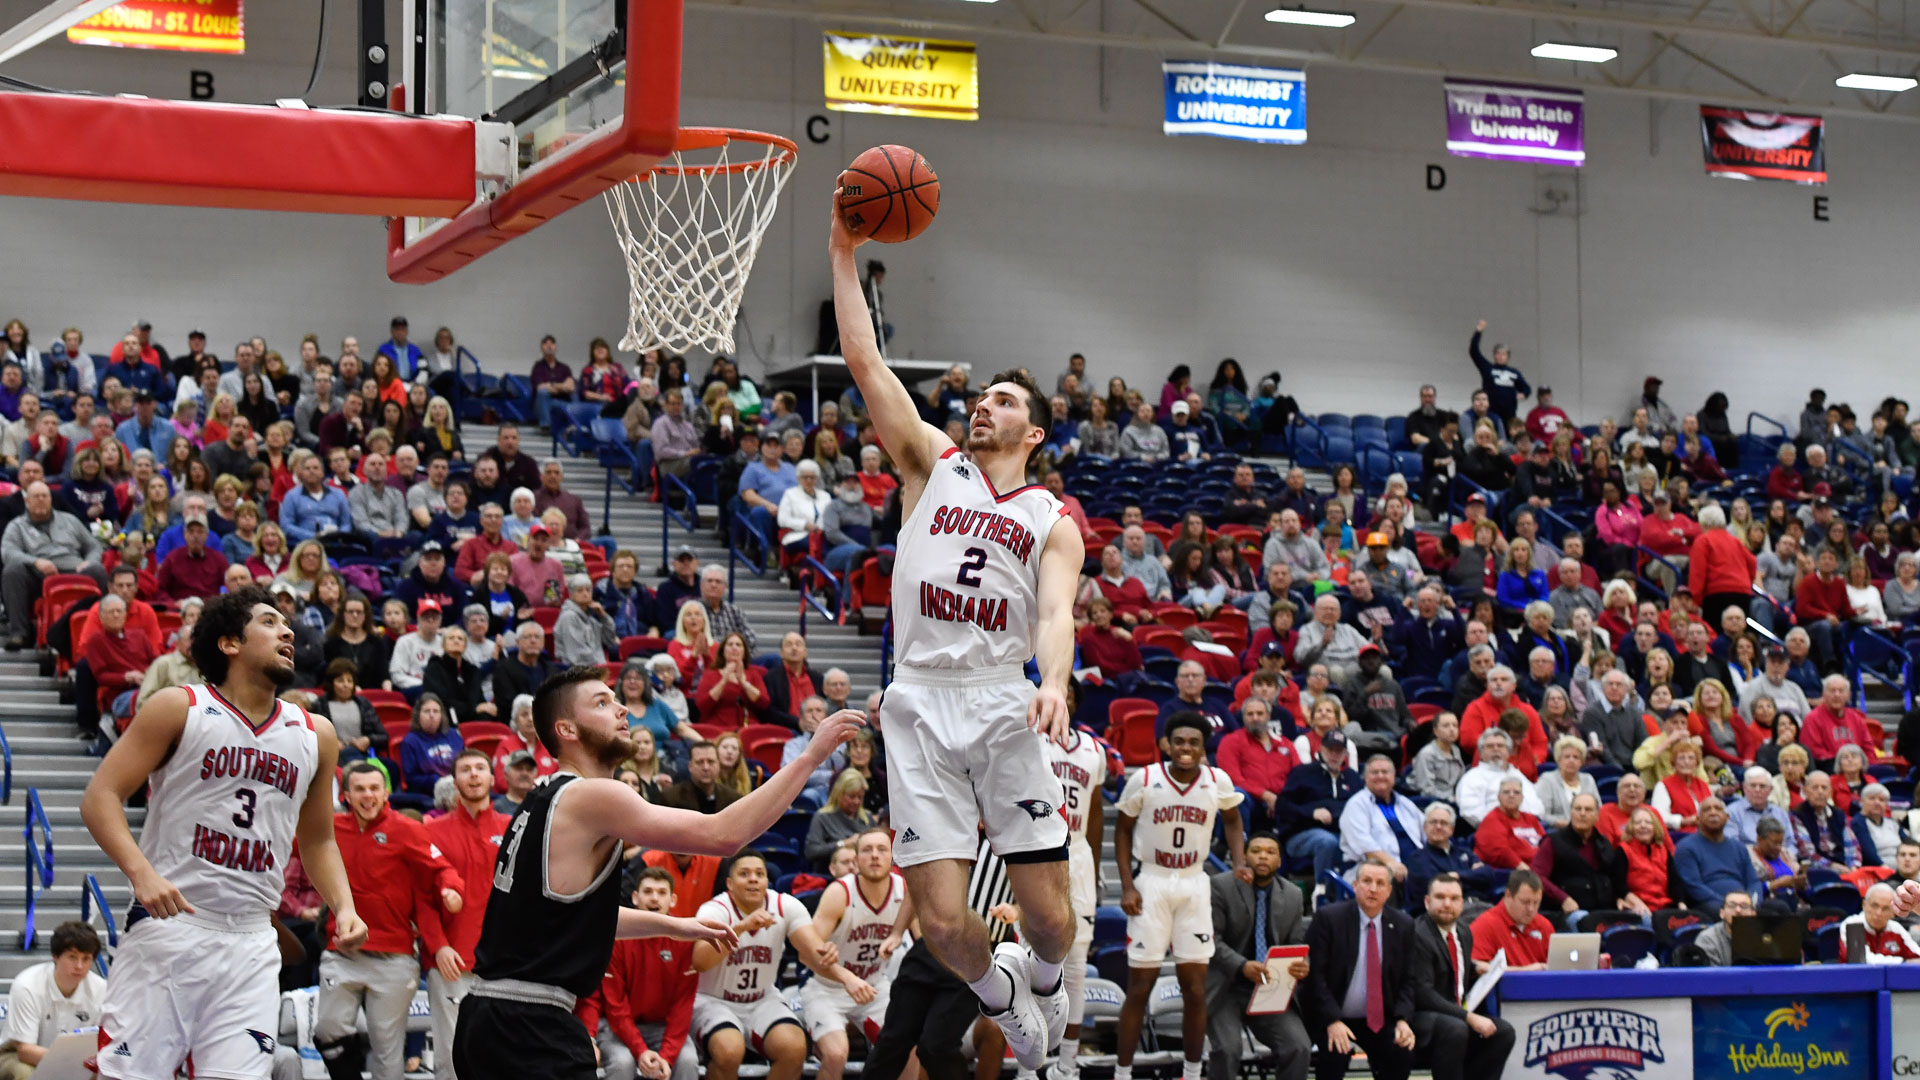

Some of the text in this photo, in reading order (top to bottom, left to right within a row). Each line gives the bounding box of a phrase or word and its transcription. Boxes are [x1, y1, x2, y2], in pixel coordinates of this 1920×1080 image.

[83, 7, 240, 35] SSOURI ST. LOUIS
[862, 51, 939, 70] QUINCY
[190, 70, 215, 99] B
[840, 76, 961, 99] UNIVERSITY
[1175, 75, 1294, 101] ROCKHURST
[1177, 101, 1292, 127] UNIVERSITY
[1454, 98, 1574, 124] Truman State
[806, 115, 830, 143] C
[1470, 119, 1559, 147] University
[1713, 142, 1813, 168] UNIVERSITY
[1426, 164, 1446, 191] D
[1814, 195, 1830, 221] E
[930, 505, 1036, 566] SOUTHERN
[956, 546, 988, 588] 2
[920, 581, 1008, 632] INDIANA
[201, 746, 299, 799] SOUTHERN
[1051, 761, 1090, 789] OUTHERN
[232, 788, 257, 829] 3
[1153, 804, 1208, 826] SOUTHERN
[192, 822, 274, 872] INDIANA
[1172, 826, 1185, 849] 0
[1155, 848, 1198, 869] INDIANA
[848, 922, 894, 942] SOUTHE
[726, 945, 772, 966] SOUTHER
[737, 968, 758, 990] 31
[1530, 1010, 1657, 1039] SOUTHERN
[1526, 1026, 1663, 1062] INDIANA
[1552, 1048, 1637, 1065] SCREAMING EAGLES
[1728, 1042, 1848, 1074] Holiday Inn
[1892, 1055, 1920, 1076] Ge
